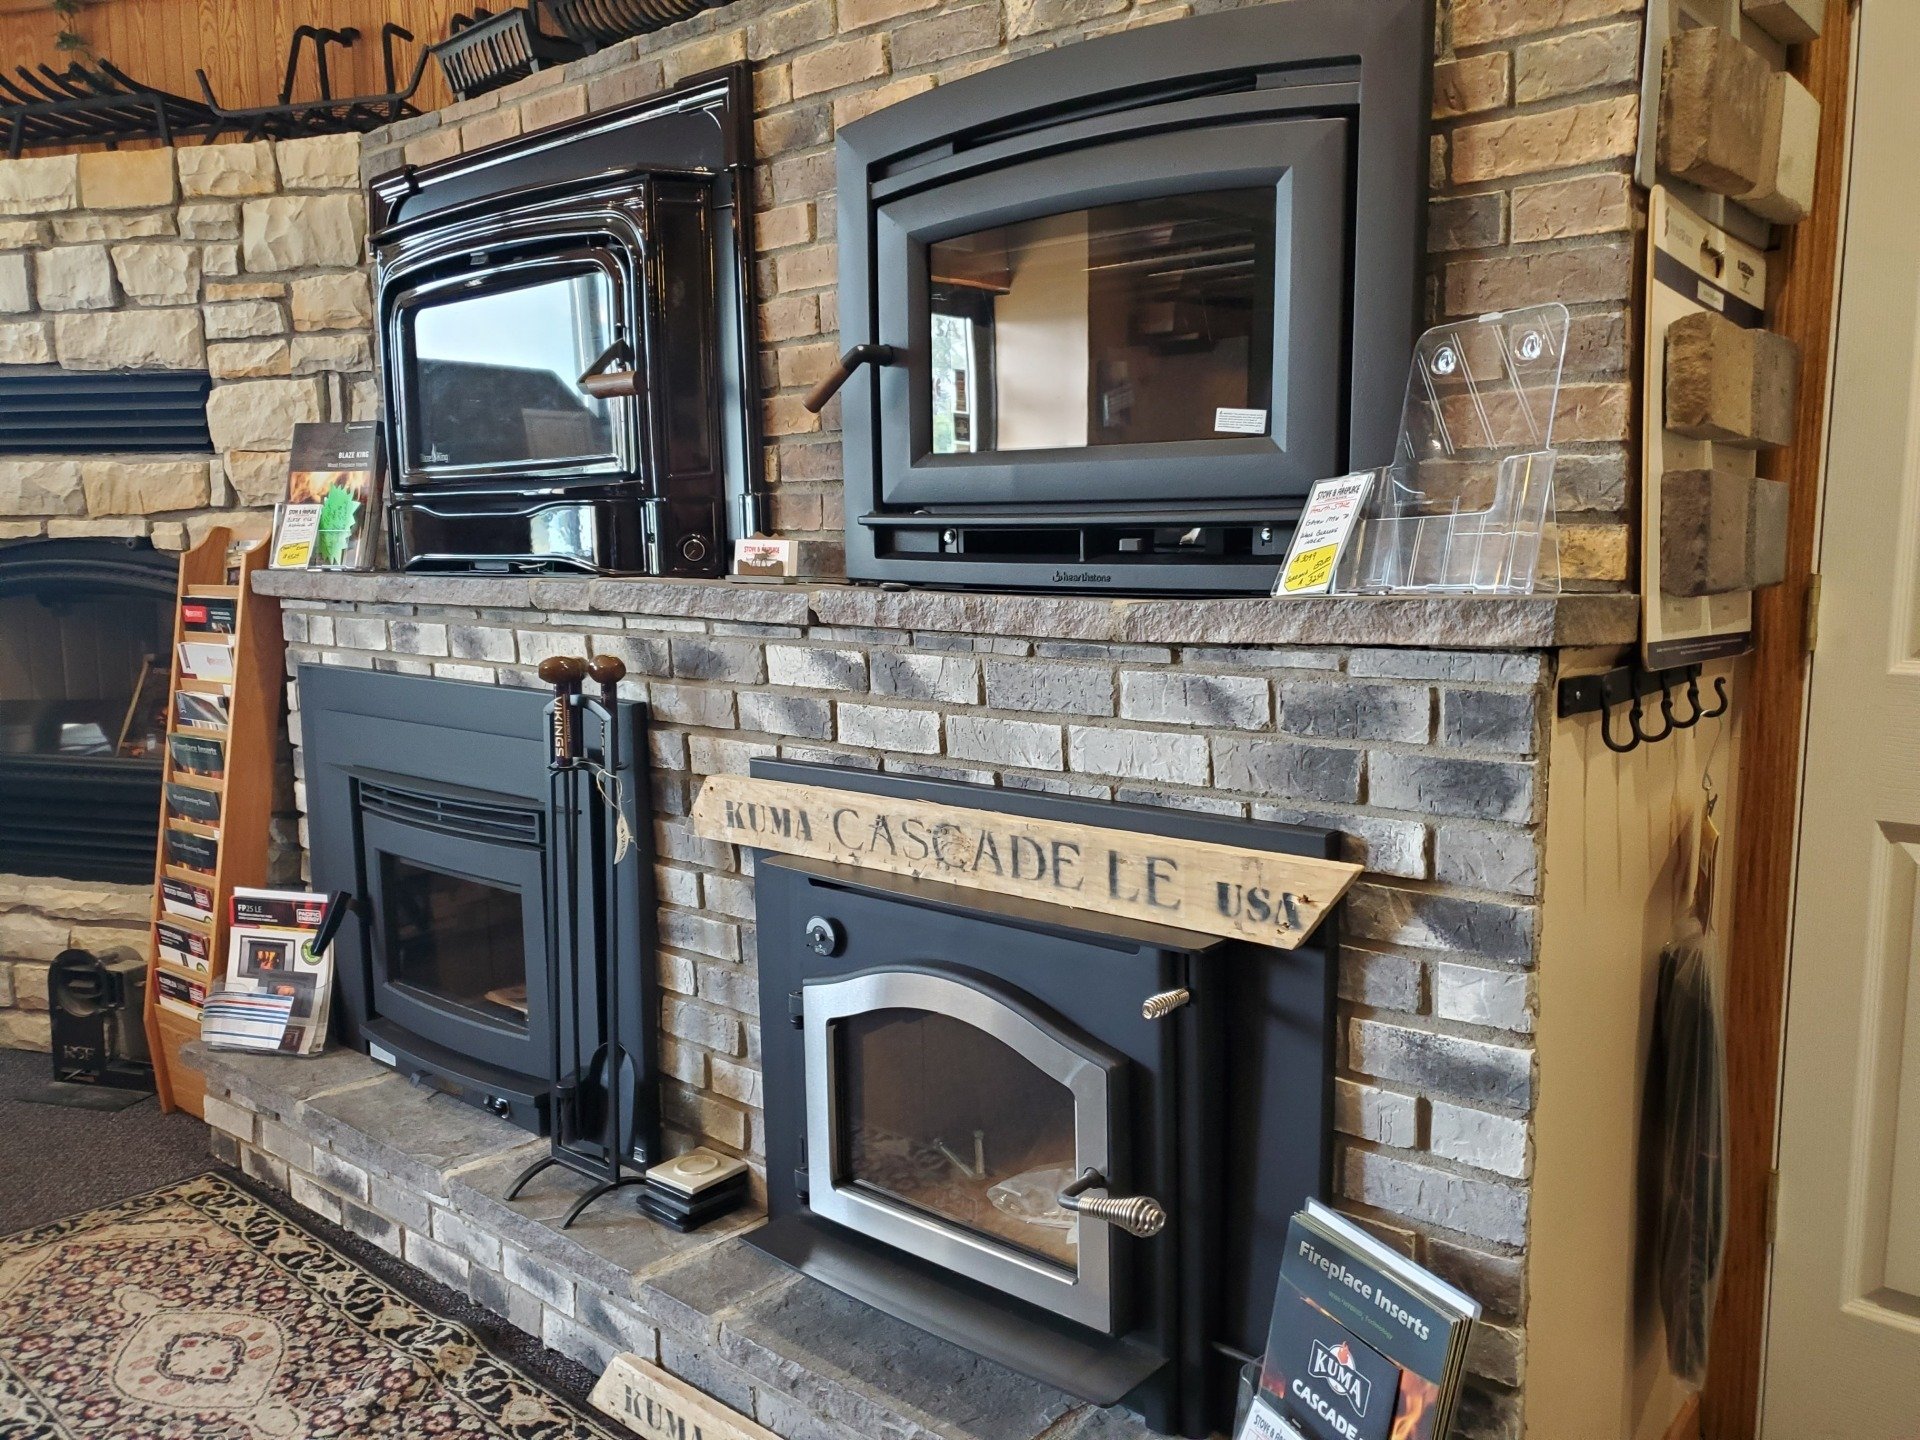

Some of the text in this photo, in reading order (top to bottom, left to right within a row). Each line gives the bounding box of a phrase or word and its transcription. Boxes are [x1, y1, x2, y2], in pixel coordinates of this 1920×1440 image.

[1063, 571, 1111, 583] hearthstone
[554, 696, 565, 757] VIKINGS
[725, 799, 1304, 932] KUMA CASCADE LE USA
[298, 915, 319, 923] ENERGY
[1299, 1240, 1372, 1299] Fireplace
[1374, 1288, 1430, 1342] Inserts
[1313, 1348, 1362, 1408] KUMA
[625, 1384, 703, 1440] KUMA
[1253, 1414, 1271, 1434] STOVE
[1292, 1378, 1358, 1440] CASCADE
